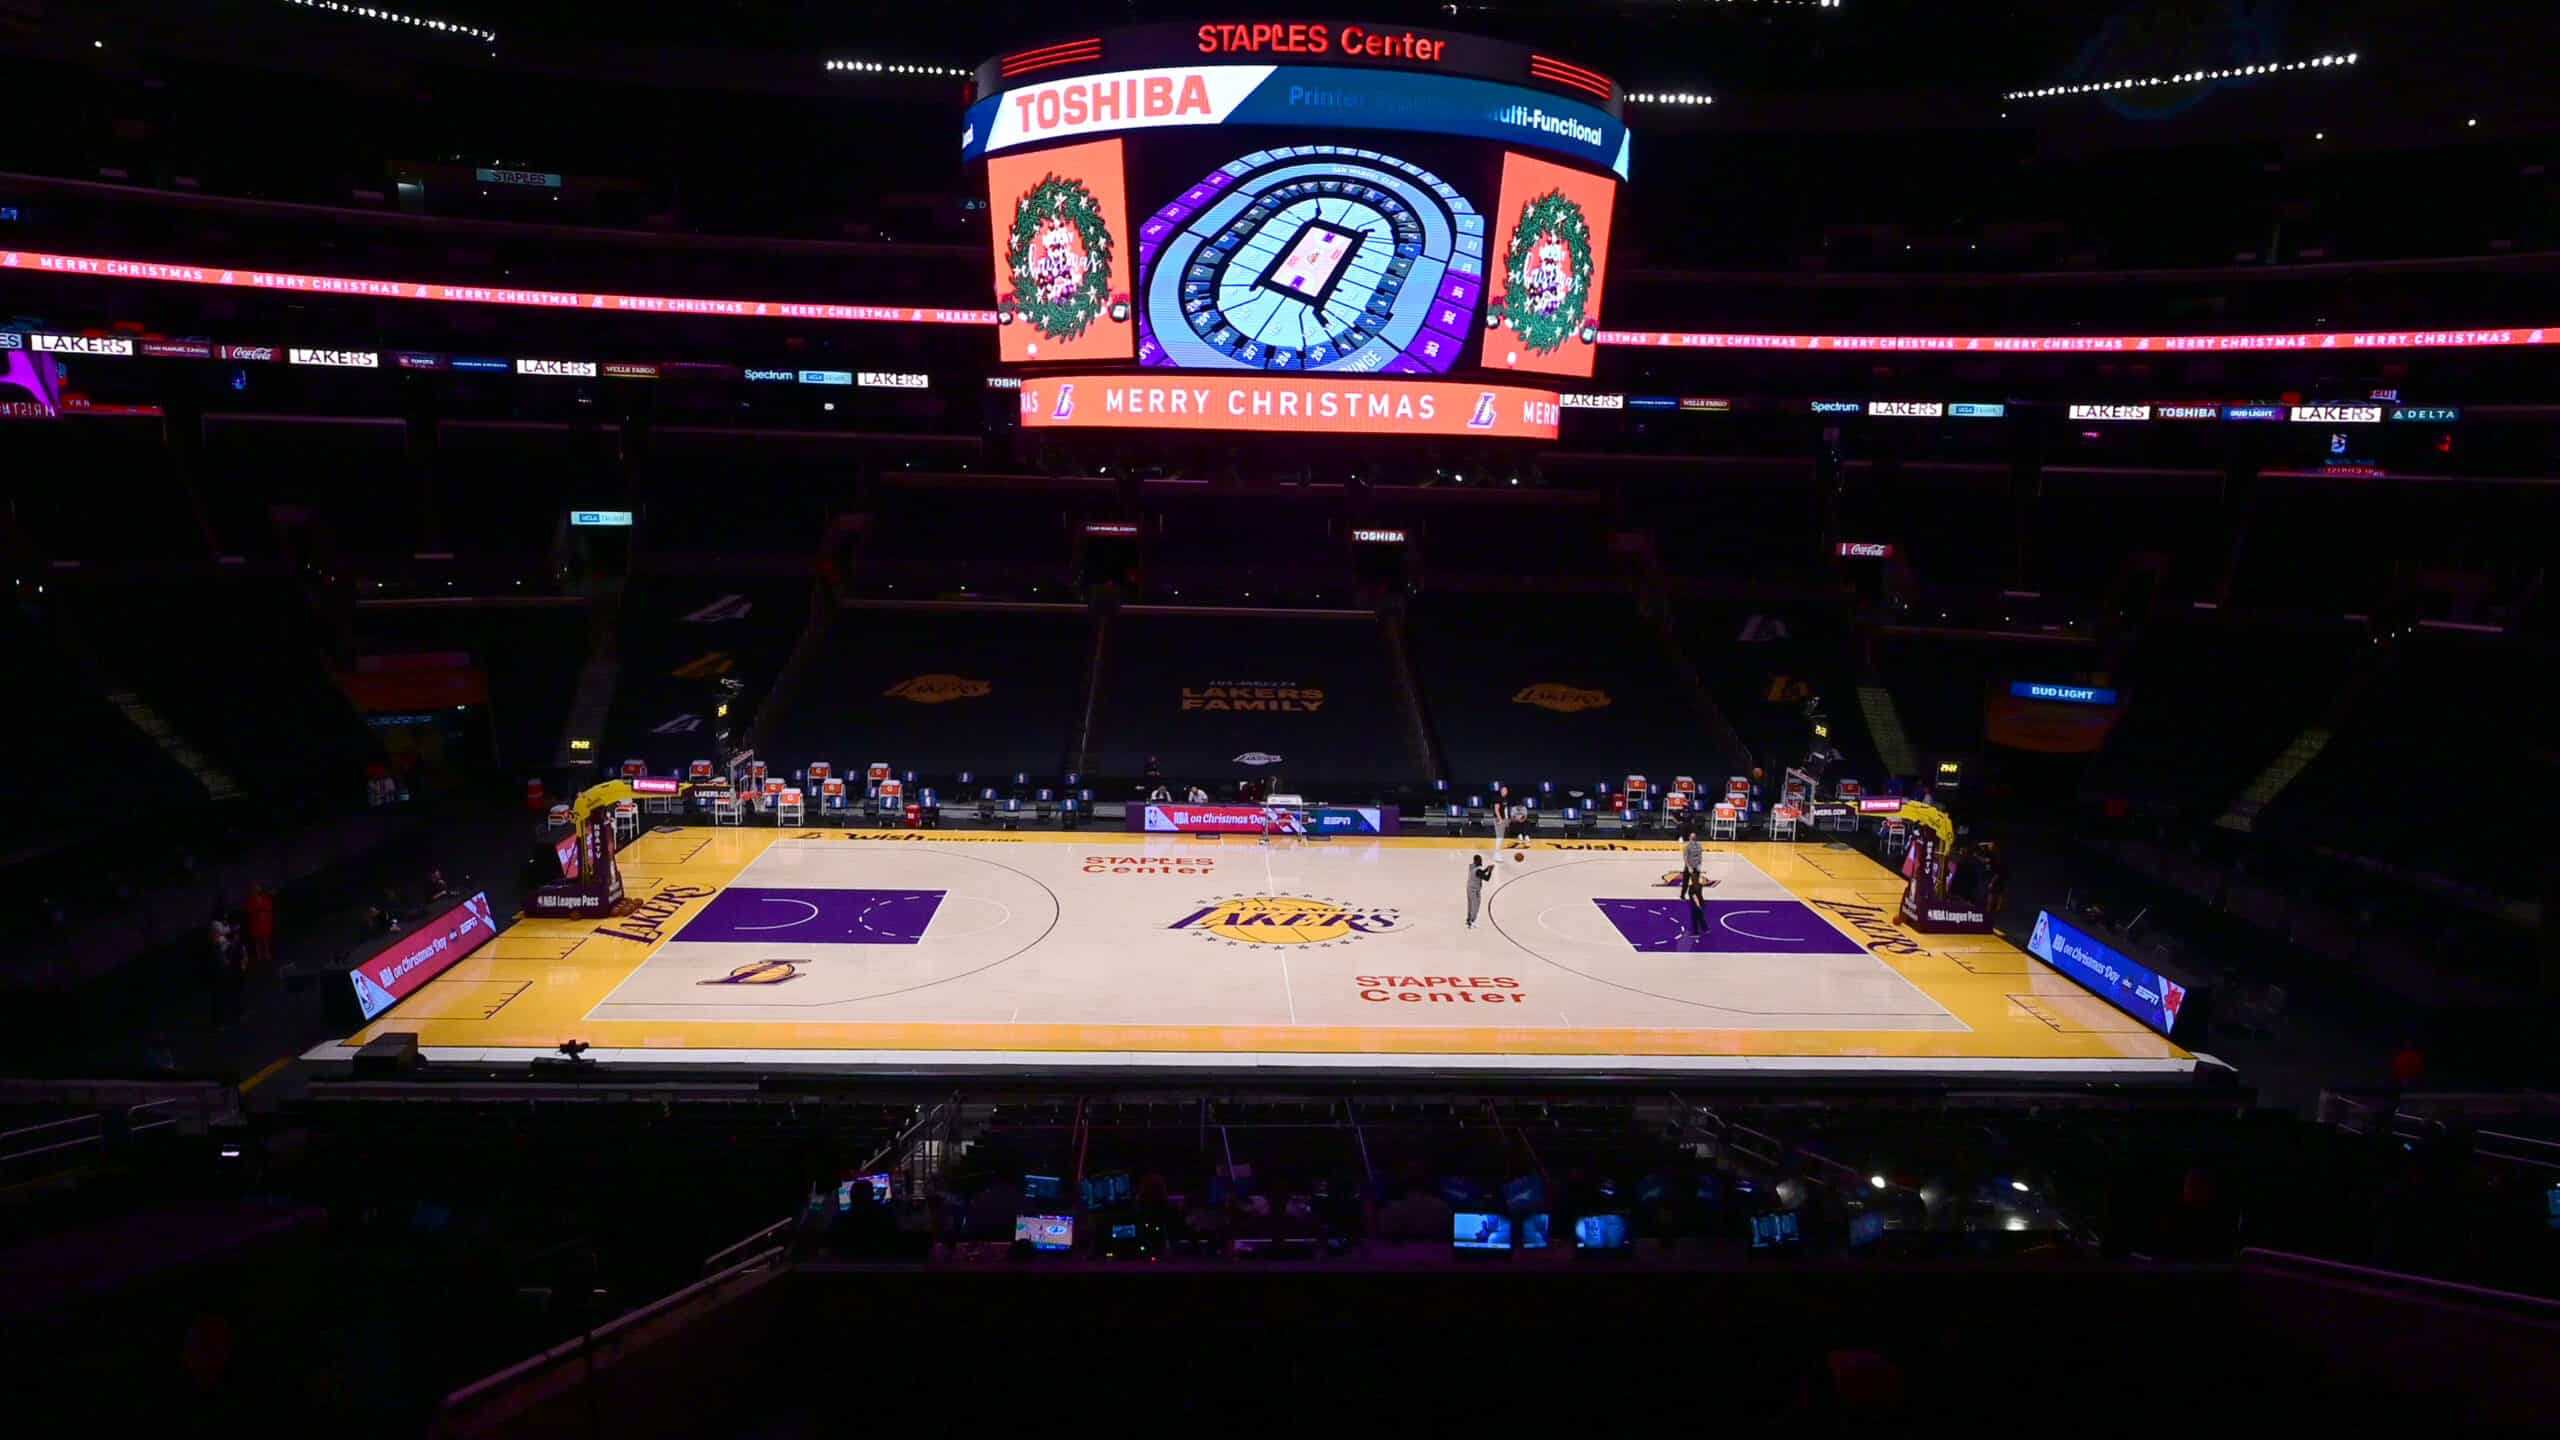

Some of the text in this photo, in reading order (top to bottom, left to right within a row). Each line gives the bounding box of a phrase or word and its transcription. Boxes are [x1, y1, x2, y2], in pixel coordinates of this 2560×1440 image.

[1198, 23, 1446, 61] STAPLES Center
[1015, 74, 1212, 133] TOSHIBA
[493, 170, 547, 185] STAPLES
[40, 256, 203, 281] MERRY CHRISTMAS
[253, 273, 400, 295] MERRY CHRISTMAS
[444, 288, 578, 305] MERRY CHRISTMAS
[619, 298, 743, 313] MERRY CHRISTMAS
[781, 305, 899, 319] MERRY CHRISTMAS
[936, 310, 977, 322] MERRY
[41, 335, 127, 354] LAKERS
[1682, 334, 1796, 347] MERRY CHRISTMAS
[1833, 338, 1953, 350] MERRY CHRISTMAS
[1993, 338, 2123, 350] MERRY CHRISTMAS
[2166, 335, 2306, 349] MERRY CHRISTMAS
[2354, 331, 2510, 345] MERRY CHRISTMAS
[296, 350, 377, 367] LAKERS
[523, 360, 592, 375] LAKERS
[744, 368, 793, 382] Spectrum
[862, 373, 924, 387] LAKERS
[988, 377, 1021, 388] TOSHI
[1105, 388, 1436, 420] MERRY CHRISTMAS
[1562, 394, 1620, 408] LAKERS
[1810, 401, 1859, 413] Spectrum
[1875, 402, 1938, 416] LAKERS
[2076, 405, 2145, 419] LAKERS
[2158, 407, 2217, 418] TOSHIBA
[2298, 407, 2376, 421] LAKERS
[2408, 409, 2455, 420] DELTA
[1353, 530, 1405, 542] TOSHIBA
[1182, 687, 1325, 699] LAKERS
[2031, 686, 2095, 700] BUD LIGHT
[1182, 699, 1324, 712] FAMILY
[1190, 815, 1202, 824] on
[1202, 812, 1248, 825] Christmas
[1323, 816, 1352, 826] ESPN
[844, 832, 925, 842] wish
[1546, 842, 1629, 852] wish
[1085, 855, 1215, 866] STAPLES
[1083, 864, 1216, 874] Center
[543, 895, 599, 909] NBA League Pass
[592, 884, 717, 946] LAKERS
[1166, 906, 1404, 933] LAKERS
[1945, 910, 1967, 923] League
[1967, 910, 1984, 922] Pass
[459, 916, 478, 936] ESPN
[393, 965, 403, 978] on
[401, 951, 435, 974] Christmas
[433, 936, 448, 953] Day
[2063, 944, 2073, 955] on
[2071, 947, 2106, 975] Christmas
[2104, 965, 2121, 985] Day
[1355, 975, 1520, 989] STAPLES
[1360, 989, 1527, 1004] Center
[2135, 984, 2160, 1006] ESPN
